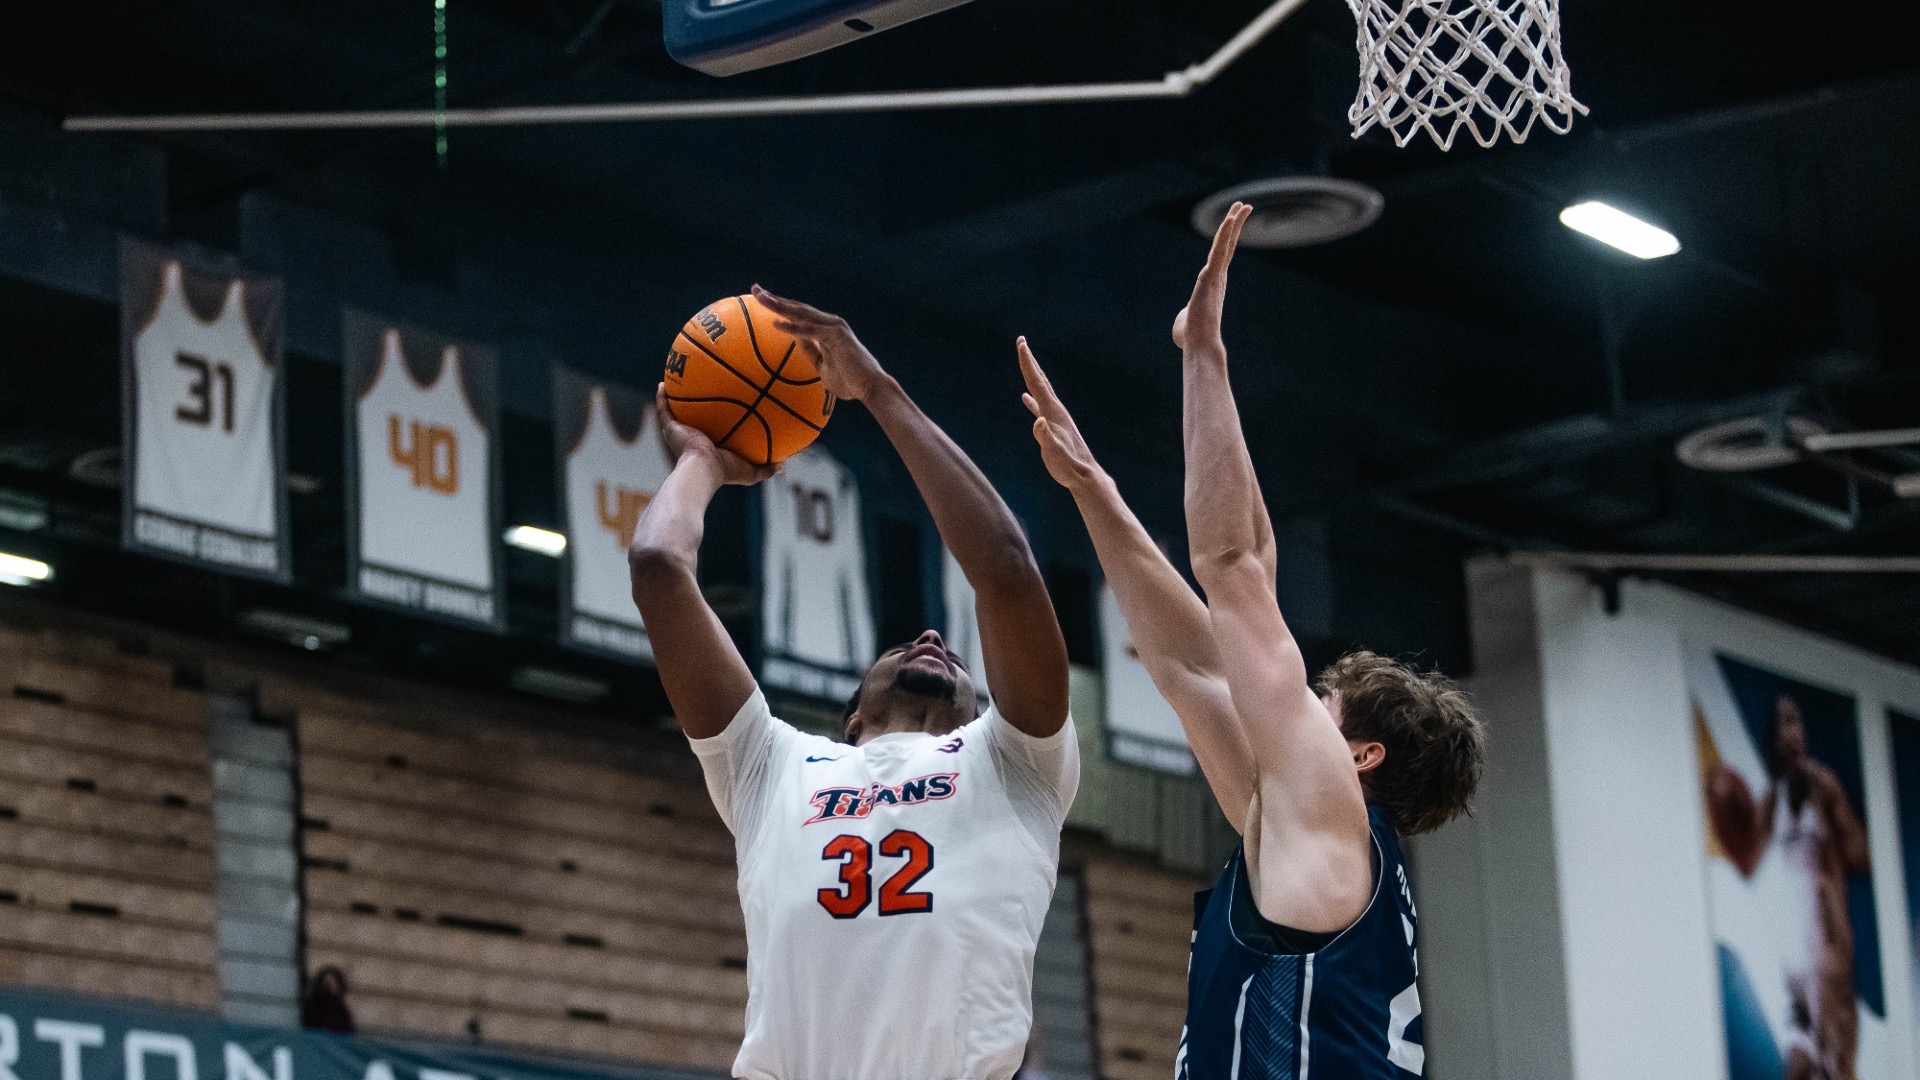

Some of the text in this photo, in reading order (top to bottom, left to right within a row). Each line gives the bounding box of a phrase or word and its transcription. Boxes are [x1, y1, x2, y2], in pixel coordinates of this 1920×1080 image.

[173, 351, 235, 435] 31
[665, 348, 688, 378] AA
[387, 412, 460, 497] 40
[791, 483, 836, 543] 10
[817, 829, 934, 919] 32
